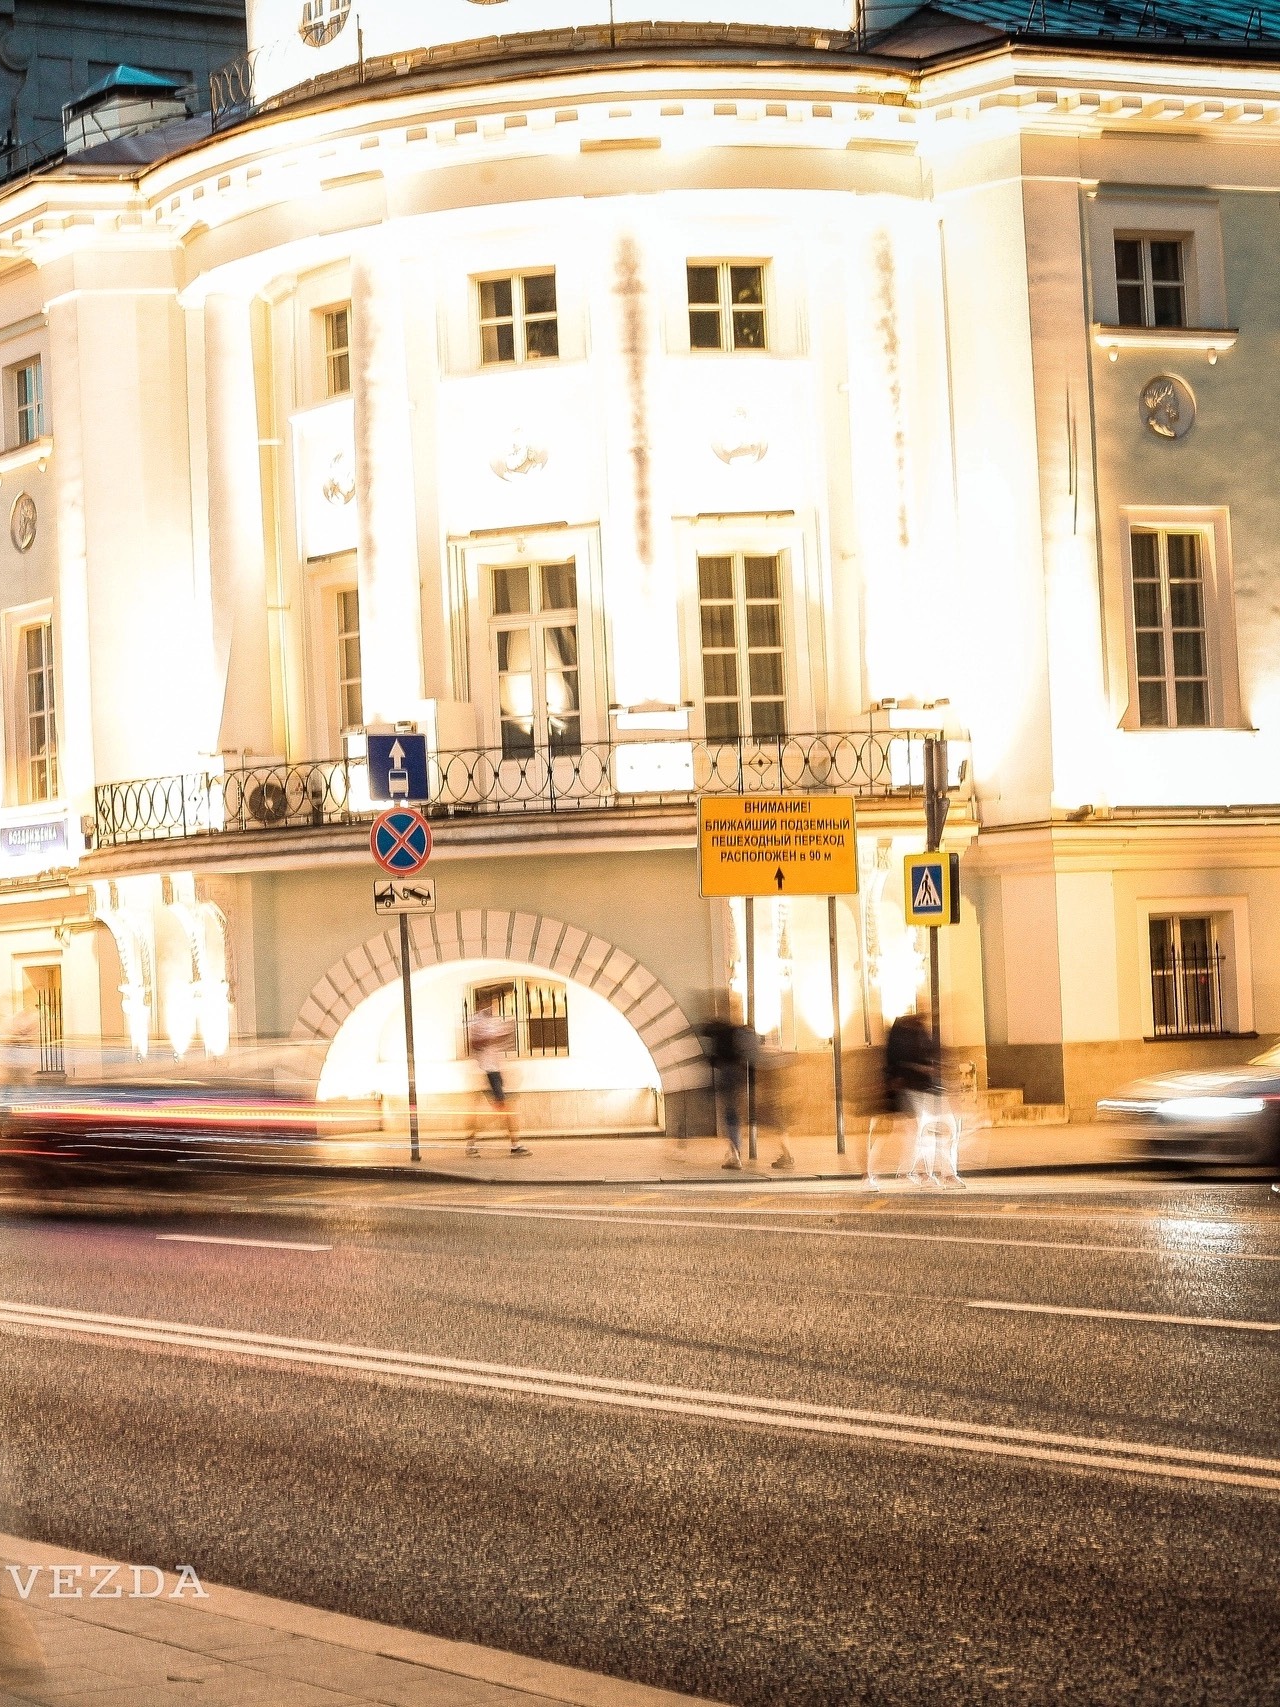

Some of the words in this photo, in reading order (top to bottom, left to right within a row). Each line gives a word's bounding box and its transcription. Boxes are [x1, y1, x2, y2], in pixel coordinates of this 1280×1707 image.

[744, 801, 811, 813] ВНИМАНИЕ!
[705, 818, 777, 831] БЛИЖАЙШИЙ
[780, 817, 850, 832] ПОДЗЕМНЫЙ
[711, 833, 791, 847] ПЕШЕХОДНЫЙ
[794, 834, 845, 847] ПЕРЕХОД
[720, 850, 797, 862] РАСПОЛОЖЕН
[809, 850, 821, 861] 90
